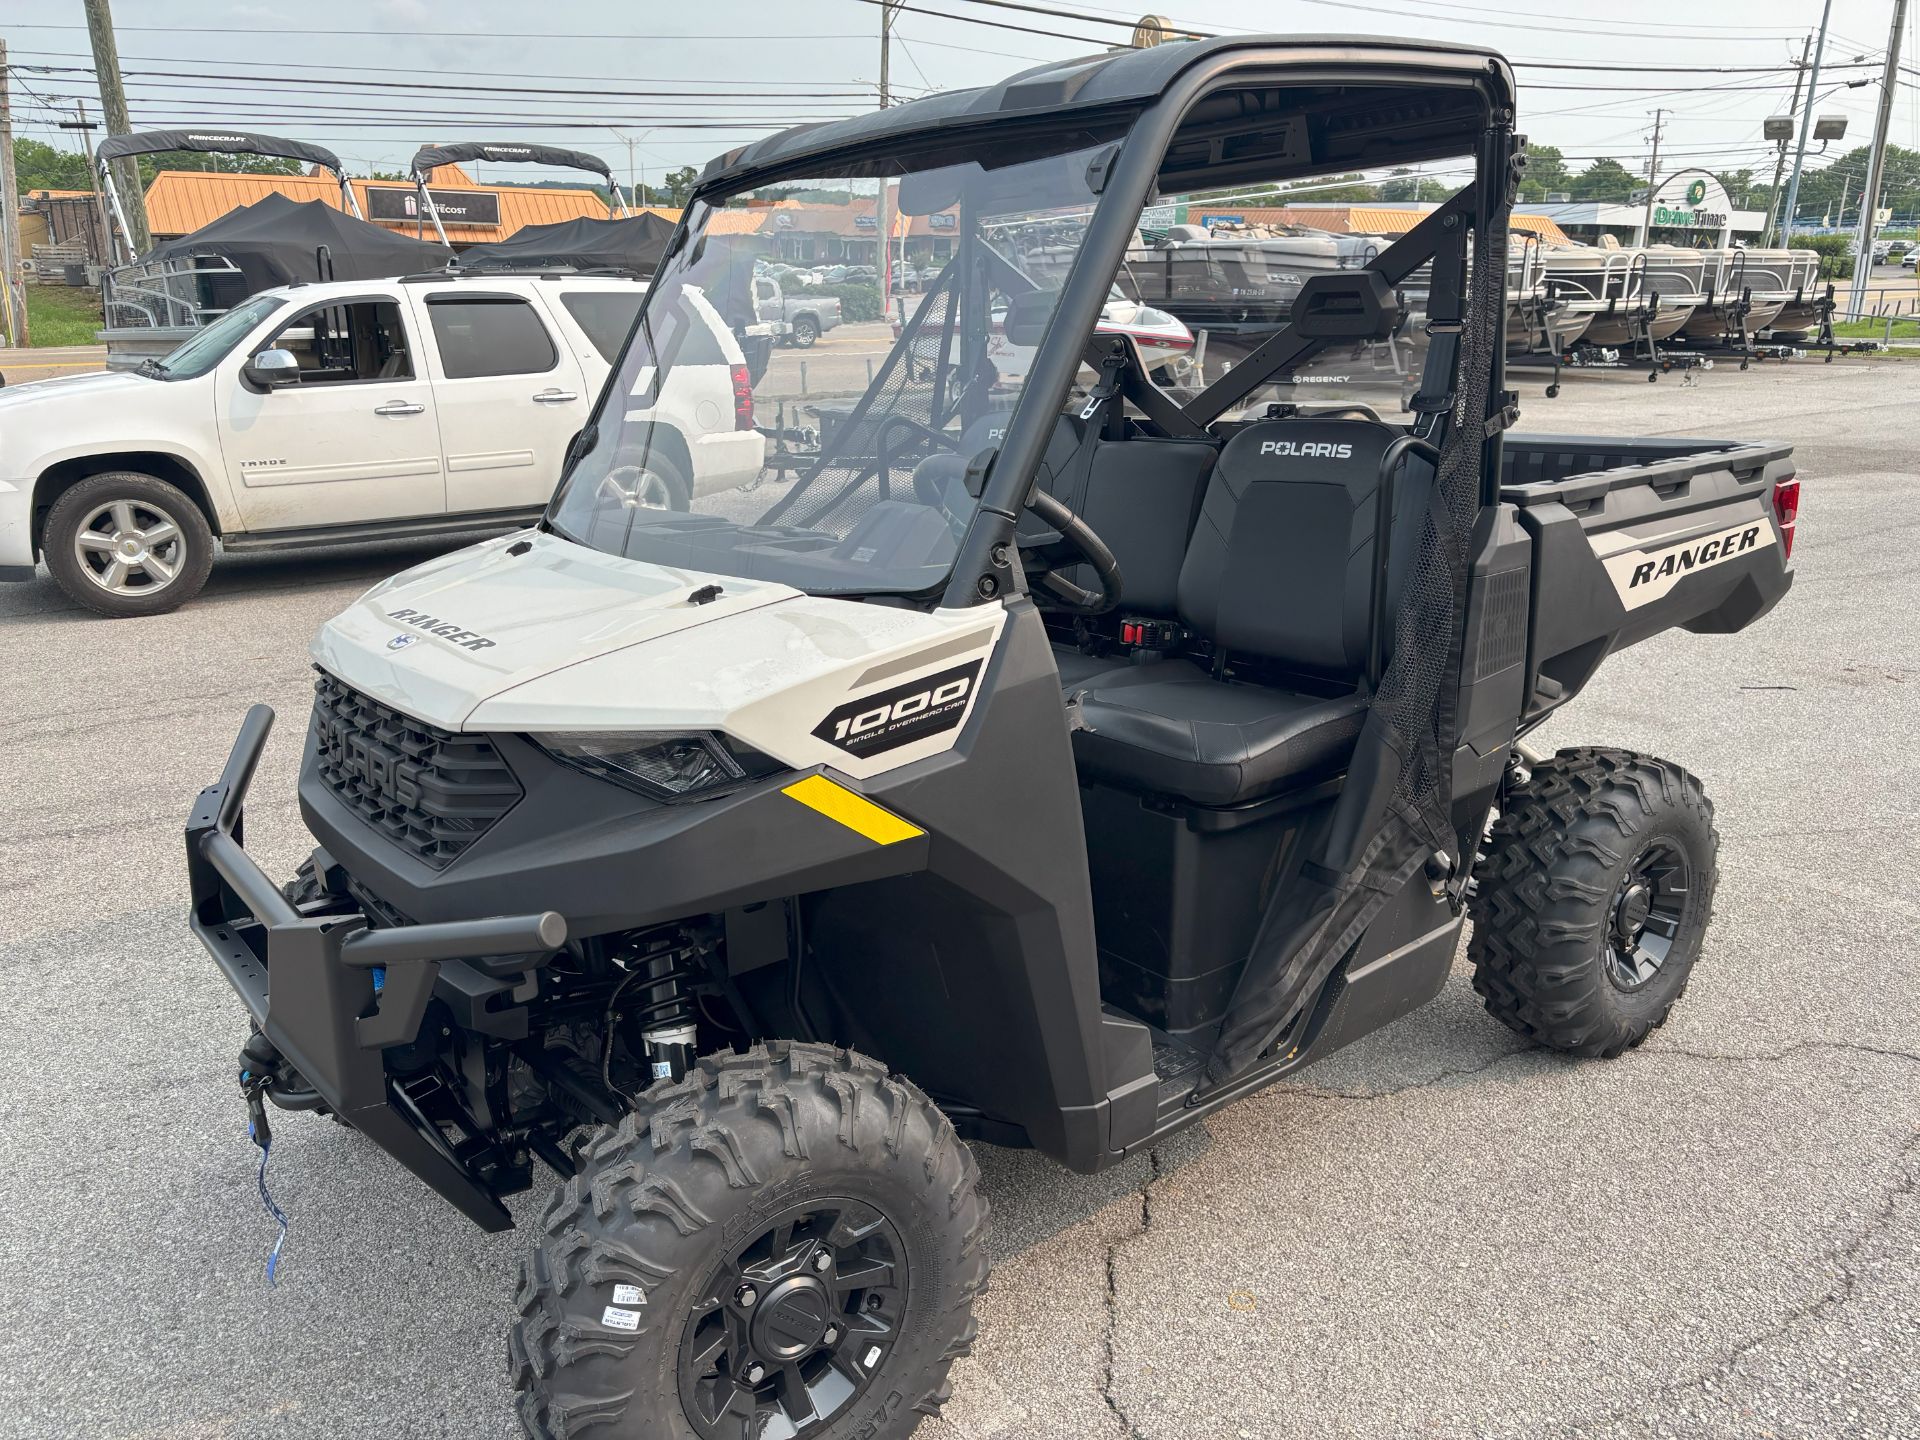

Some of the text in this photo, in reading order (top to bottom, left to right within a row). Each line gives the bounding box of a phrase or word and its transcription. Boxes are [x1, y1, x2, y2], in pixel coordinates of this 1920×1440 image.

[188, 134, 247, 142] PRINCECRAFT
[483, 146, 531, 154] PRINCECRAFT
[1655, 206, 1727, 227] DriveTime
[1302, 375, 1351, 383] REGENCY
[1260, 441, 1353, 459] POLARIS
[240, 459, 287, 467] TAHOE
[1629, 526, 1760, 589] RANGER
[386, 608, 497, 652] RANGER
[834, 677, 970, 741] 1000
[846, 699, 967, 746] SINGLE OVERHEAD CAM
[313, 701, 424, 811] POLARIS
